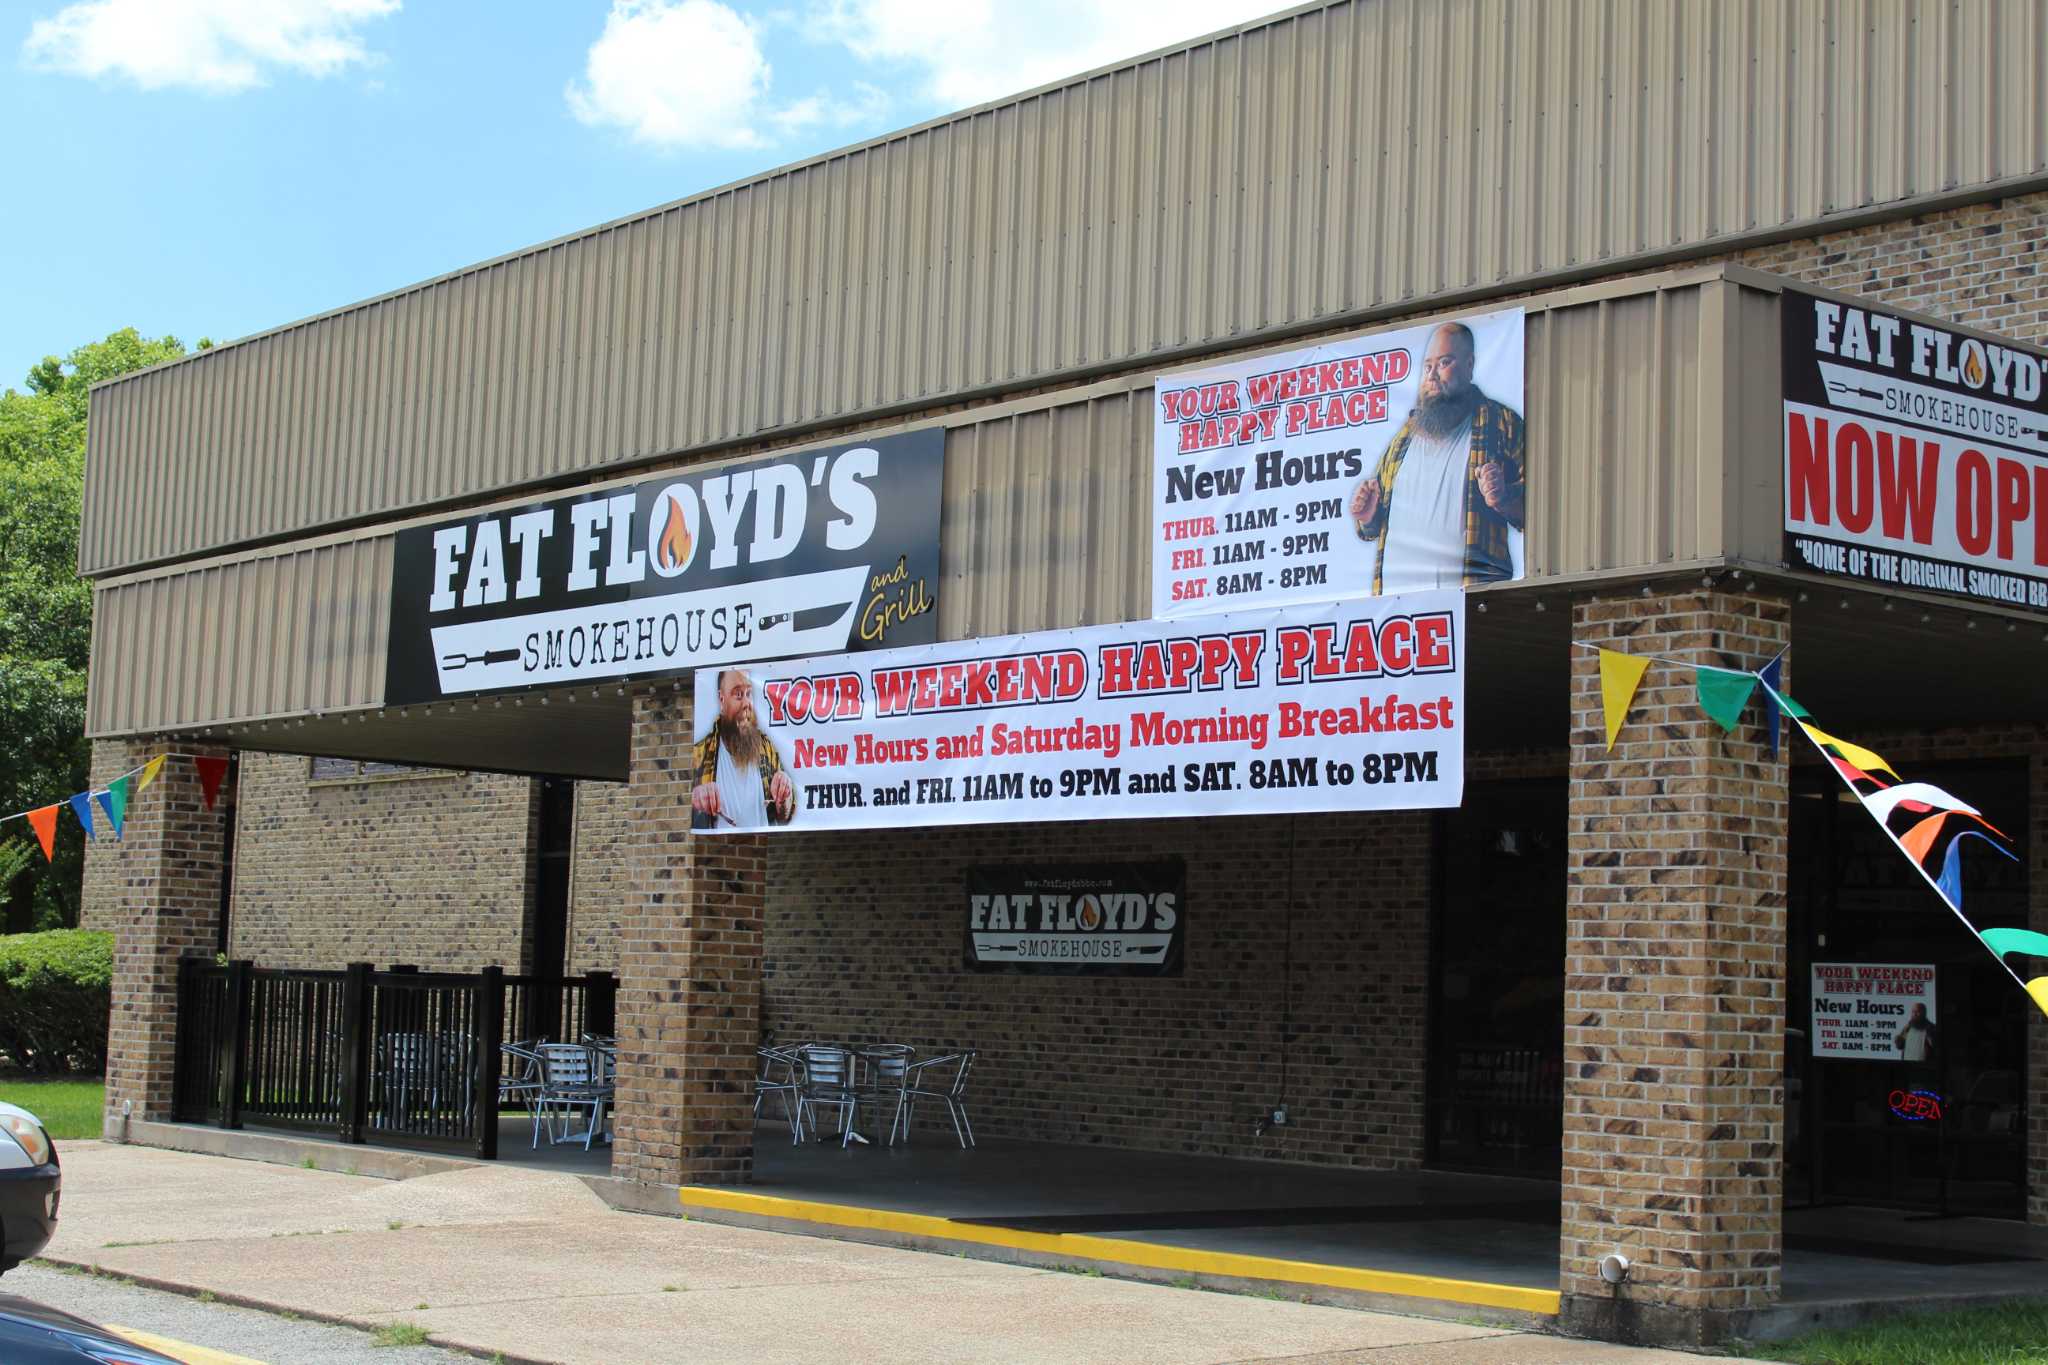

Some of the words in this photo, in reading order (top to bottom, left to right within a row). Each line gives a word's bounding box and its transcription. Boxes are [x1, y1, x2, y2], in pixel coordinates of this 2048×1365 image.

[1815, 300, 1900, 368] FAT
[1161, 380, 1240, 423] YOUR
[1247, 347, 1412, 406] WEEKEND
[1178, 406, 1280, 455] HAPPY
[1285, 386, 1389, 437] PLACE
[1885, 388, 2018, 439] SMOKEHOUSE
[1165, 463, 1245, 504] New
[1254, 448, 1362, 491] Hours
[1788, 411, 1941, 546] NOW
[429, 509, 555, 613] FAT
[567, 448, 880, 591] FLOYD'S
[1162, 515, 1219, 541] THUR.
[1225, 506, 1278, 533] 11AM
[1295, 498, 1343, 524] 9PM
[1171, 548, 1207, 571] FRI.
[1212, 539, 1265, 567] 11AM
[1282, 532, 1329, 558] 9PM
[870, 559, 909, 594] and
[1171, 577, 1211, 601] SAT.
[1216, 571, 1263, 596] 8AM
[1279, 564, 1327, 589] 8PM
[1850, 548, 1868, 577] OF
[1870, 553, 1898, 582] THE
[1901, 561, 1968, 593] ORIGINAL
[1969, 570, 2026, 603] SMOKED
[859, 578, 934, 642] Grill
[523, 602, 754, 673] SMOKEHOUSE
[764, 671, 865, 727] YOUR
[871, 648, 1089, 718] WEEKEND
[1098, 629, 1267, 700] HAPPY
[1276, 610, 1456, 686] PLACE
[793, 737, 849, 770] New
[855, 731, 929, 766] Hours
[935, 725, 985, 759] and
[990, 716, 1122, 759] Saturday
[1129, 707, 1270, 751] Morning
[1278, 694, 1454, 739] Breakfast
[804, 782, 868, 810] THUR.
[872, 778, 912, 807] and
[916, 777, 957, 804] FRI.
[962, 772, 1025, 802] 11AM
[1029, 773, 1054, 798] to
[1059, 767, 1121, 797] 9PM
[1128, 764, 1177, 795] and
[1183, 761, 1242, 793] SAT.
[1248, 756, 1318, 789] 8AM
[1325, 759, 1355, 786] to
[1362, 751, 1439, 784] 8PM
[970, 894, 1033, 930] FAT
[1039, 892, 1177, 931] FLOYD'S
[1018, 939, 1123, 958] SMOKEHOUSE
[1815, 965, 1853, 980] YOUR
[1856, 966, 1934, 982] WEEKEND
[1823, 978, 1873, 994] HAPPY
[1876, 980, 1926, 996] PLACE
[1814, 998, 1852, 1014] New
[1856, 999, 1905, 1015] Hours
[1844, 1019, 1869, 1028] 11AM
[1876, 1020, 1897, 1029] 9PM
[1840, 1031, 1864, 1040] 11AM
[1871, 1032, 1892, 1041] 9PM
[1841, 1042, 1863, 1051] 8AM
[1870, 1043, 1892, 1052] 8PM
[1888, 1089, 1948, 1120] OPEN
